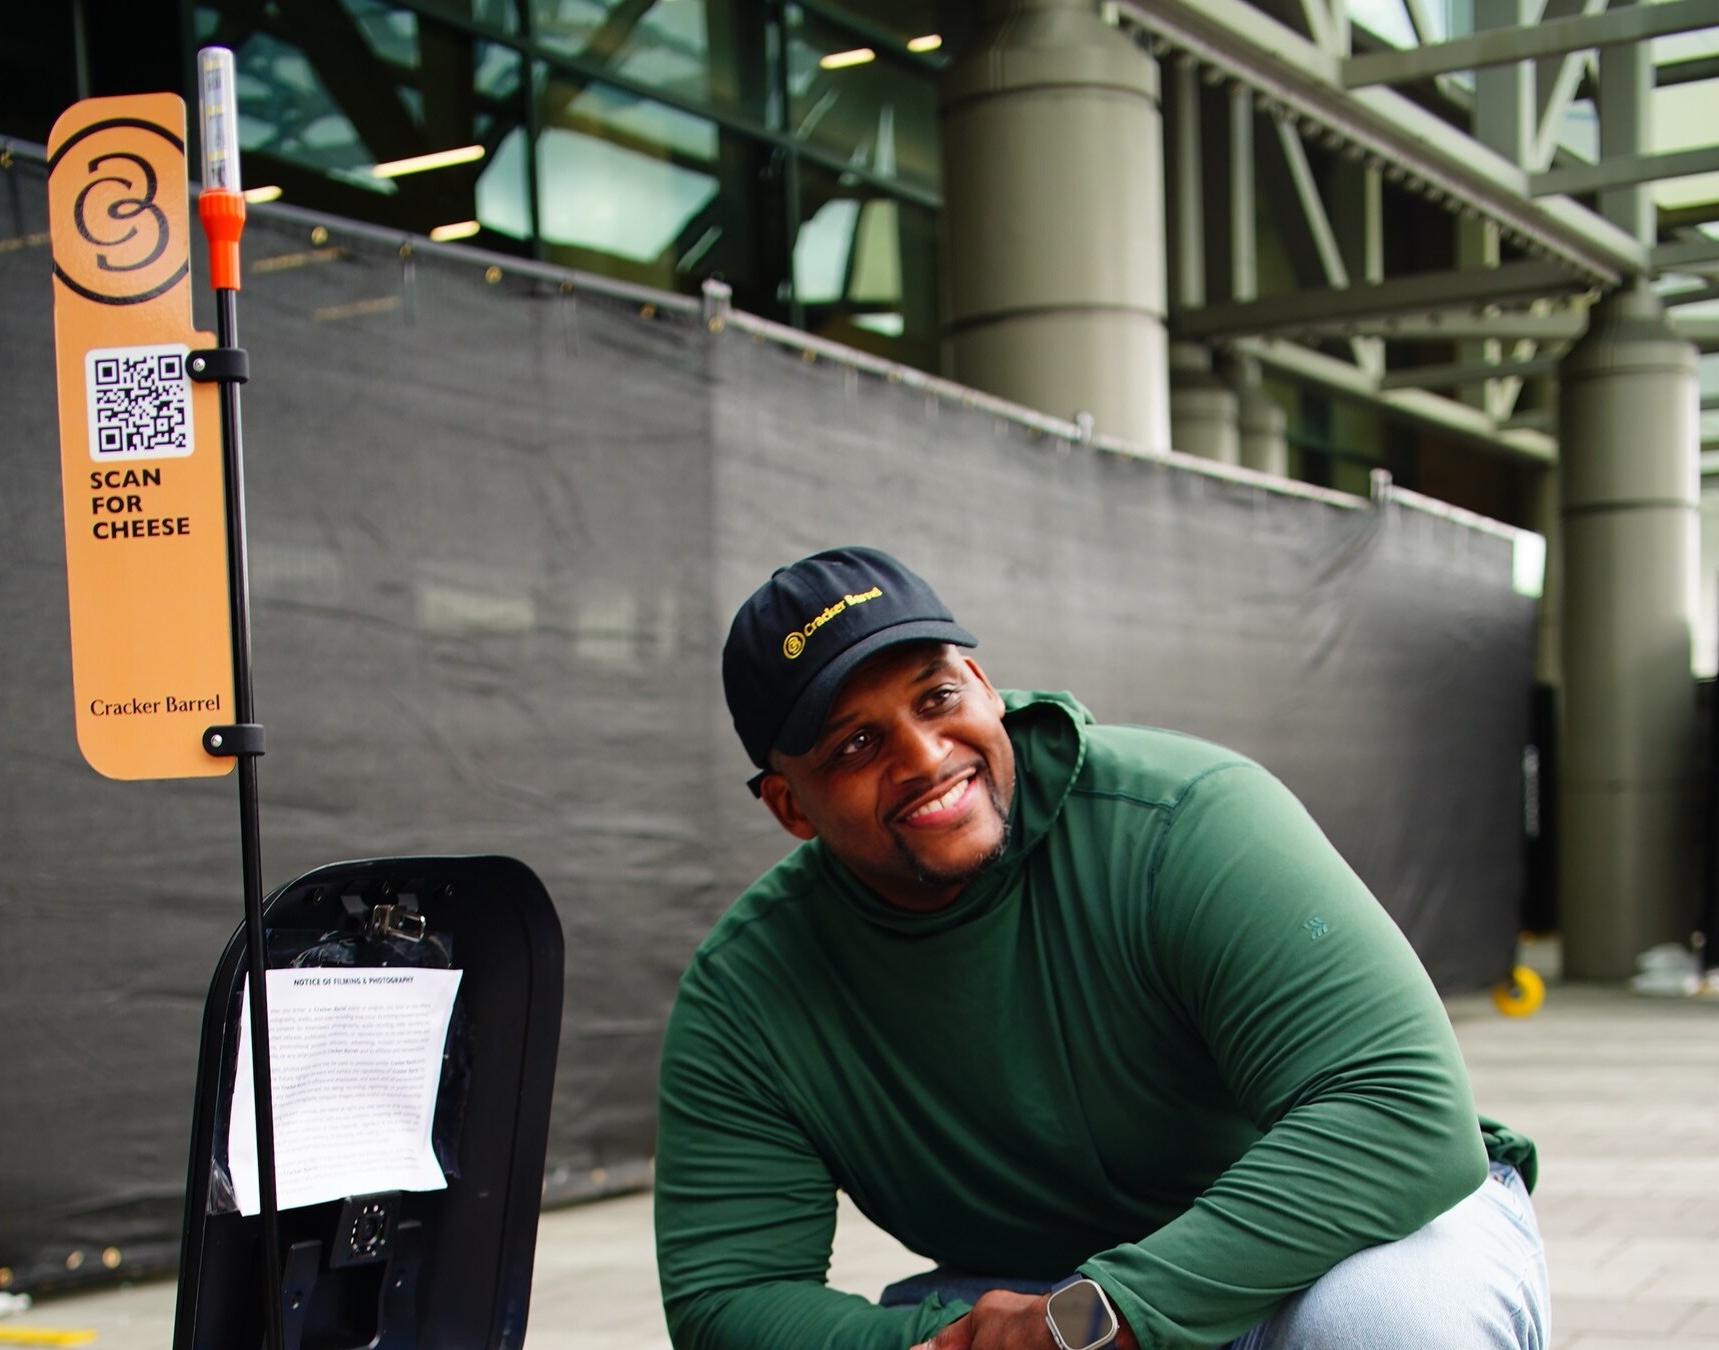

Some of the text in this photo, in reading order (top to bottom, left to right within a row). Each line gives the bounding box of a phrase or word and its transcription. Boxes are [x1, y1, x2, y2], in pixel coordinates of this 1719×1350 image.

[90, 468, 161, 490] SCAN
[92, 495, 143, 515] FOR
[93, 517, 190, 540] CHEESE
[90, 694, 220, 717] Cracker Barrel
[293, 978, 320, 986] NOTICE
[322, 978, 332, 986] OF
[333, 977, 361, 985] FILMING
[369, 976, 414, 984] PHOTOGRAPHY
